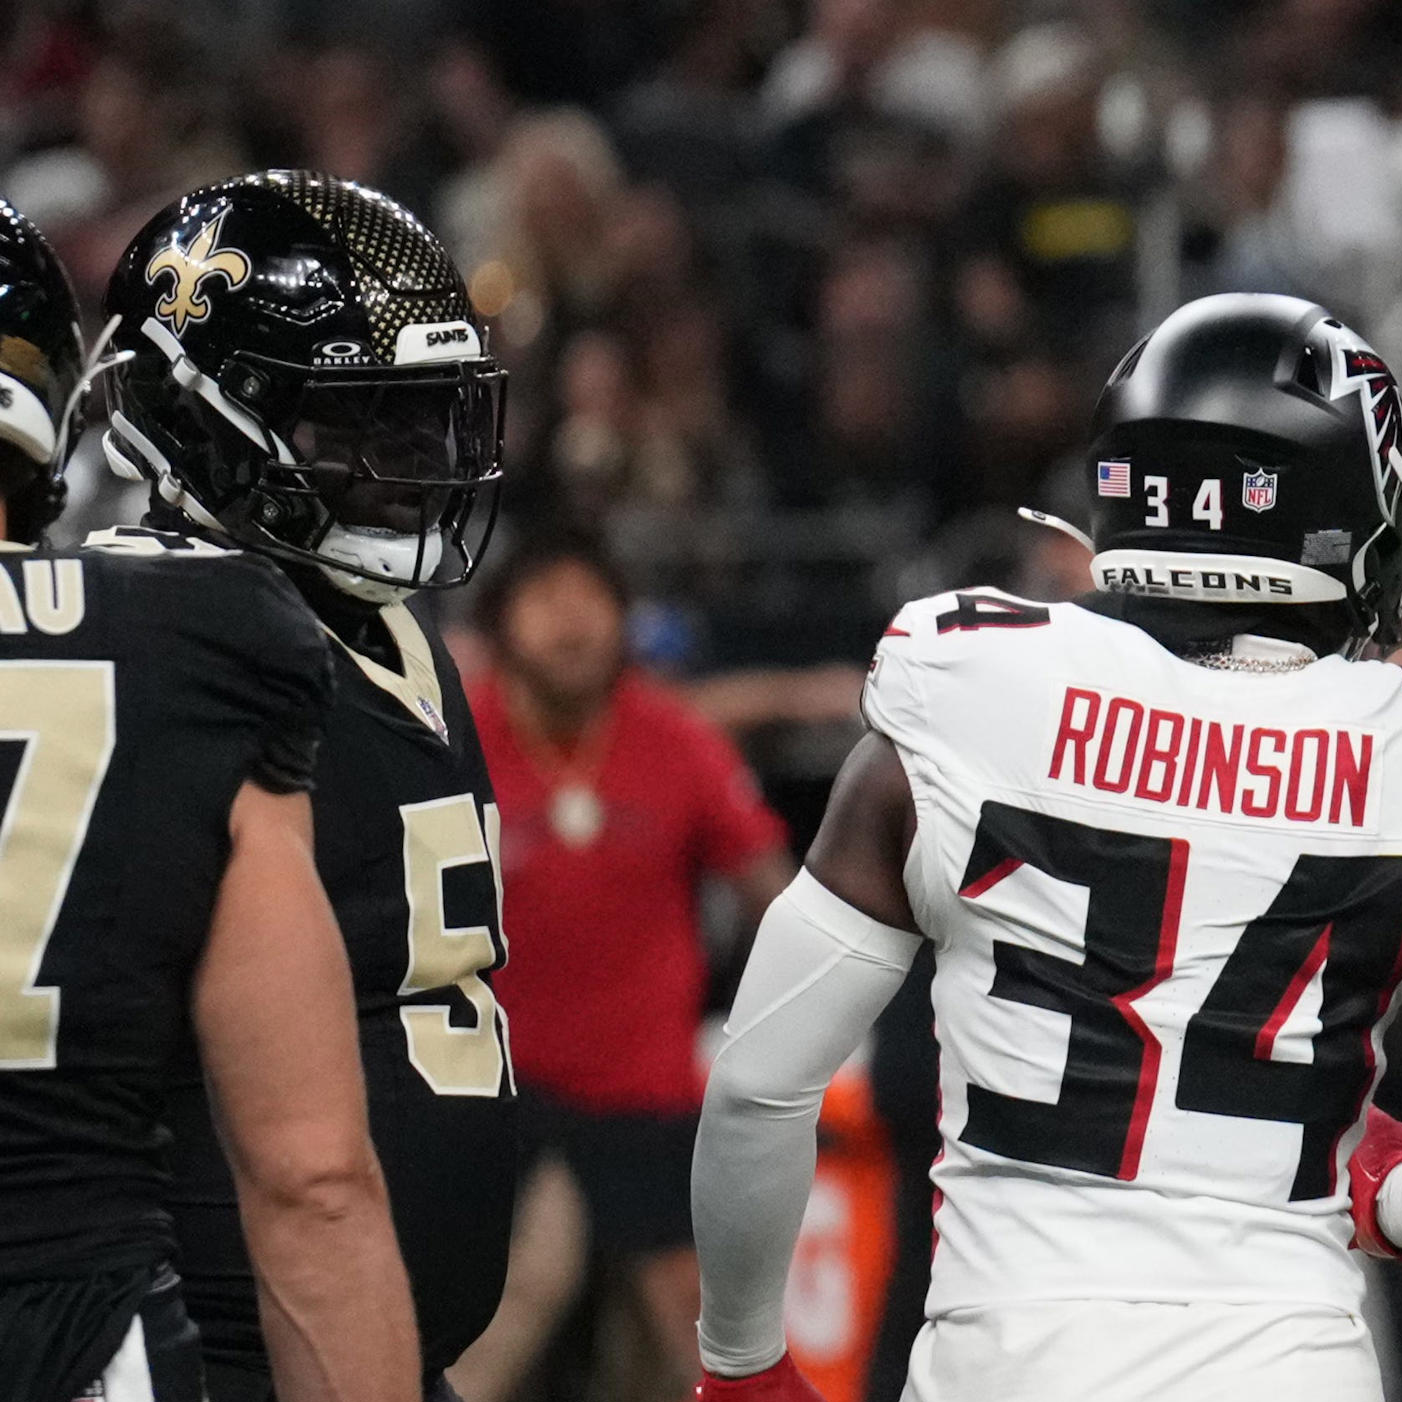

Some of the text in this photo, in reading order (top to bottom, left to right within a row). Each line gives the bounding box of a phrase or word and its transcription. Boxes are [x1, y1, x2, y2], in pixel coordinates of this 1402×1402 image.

[425, 328, 469, 347] SAINTS
[313, 355, 371, 365] OAKLEY
[1247, 488, 1272, 508] NFL
[1102, 567, 1294, 596] FALCONS
[1047, 686, 1374, 829] ROBINSON
[397, 792, 519, 1099] 5
